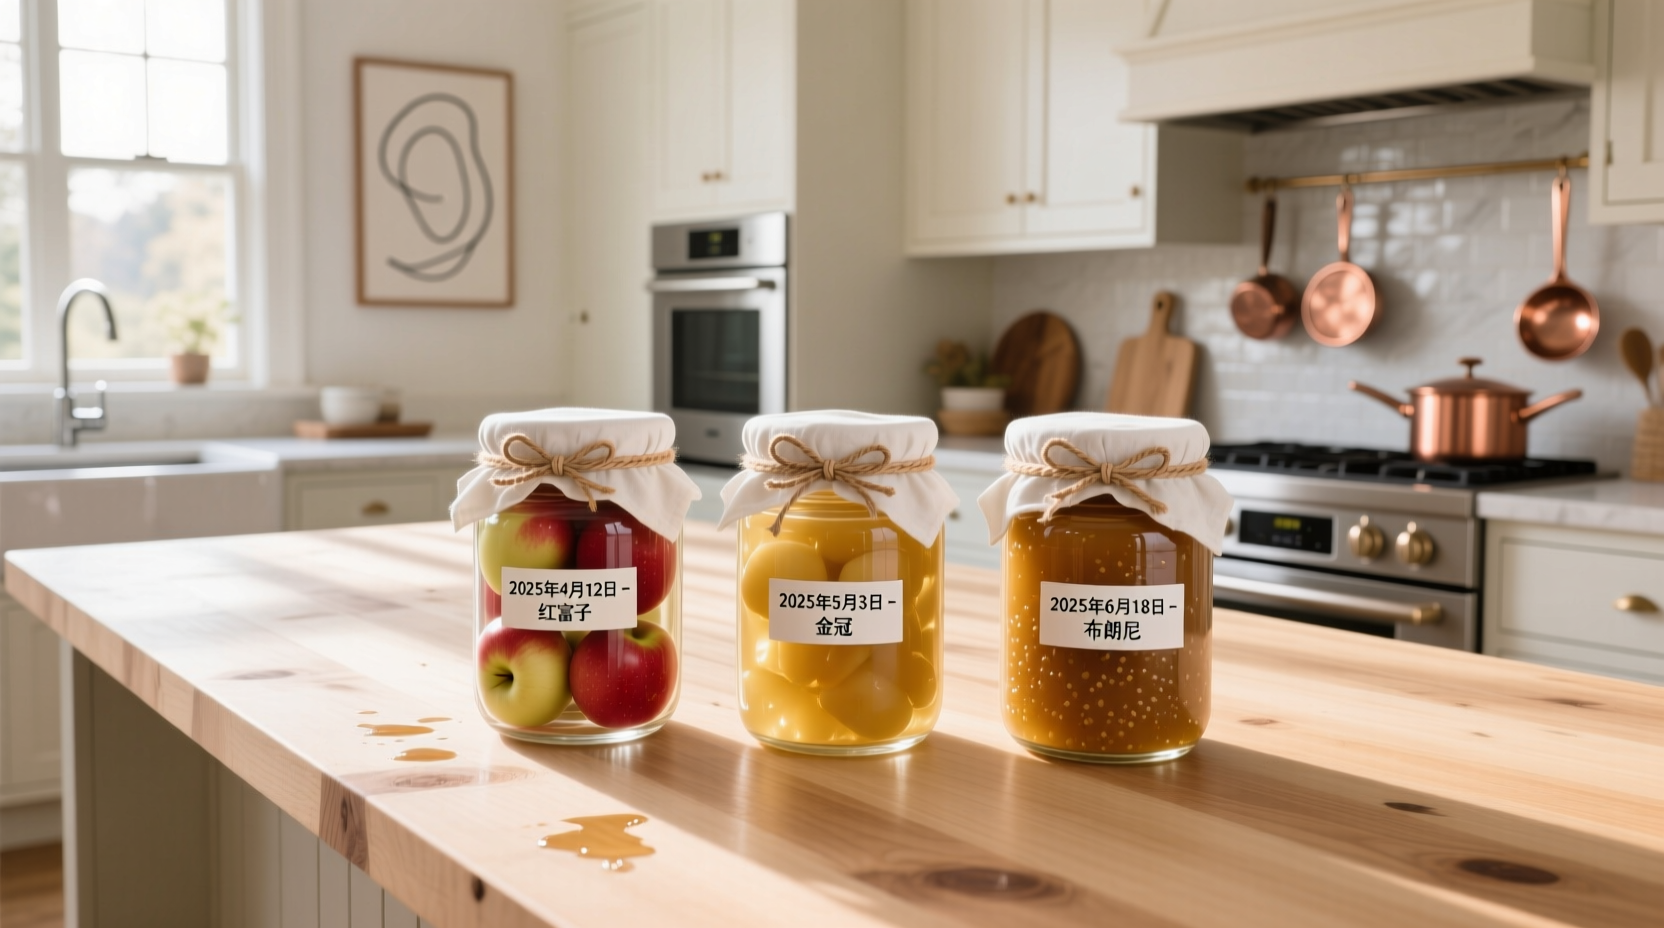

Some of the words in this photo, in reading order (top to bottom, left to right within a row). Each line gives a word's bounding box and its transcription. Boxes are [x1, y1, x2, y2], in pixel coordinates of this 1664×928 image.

[815, 616, 853, 637] 金冠
[1083, 619, 1141, 641] 布朗尼
